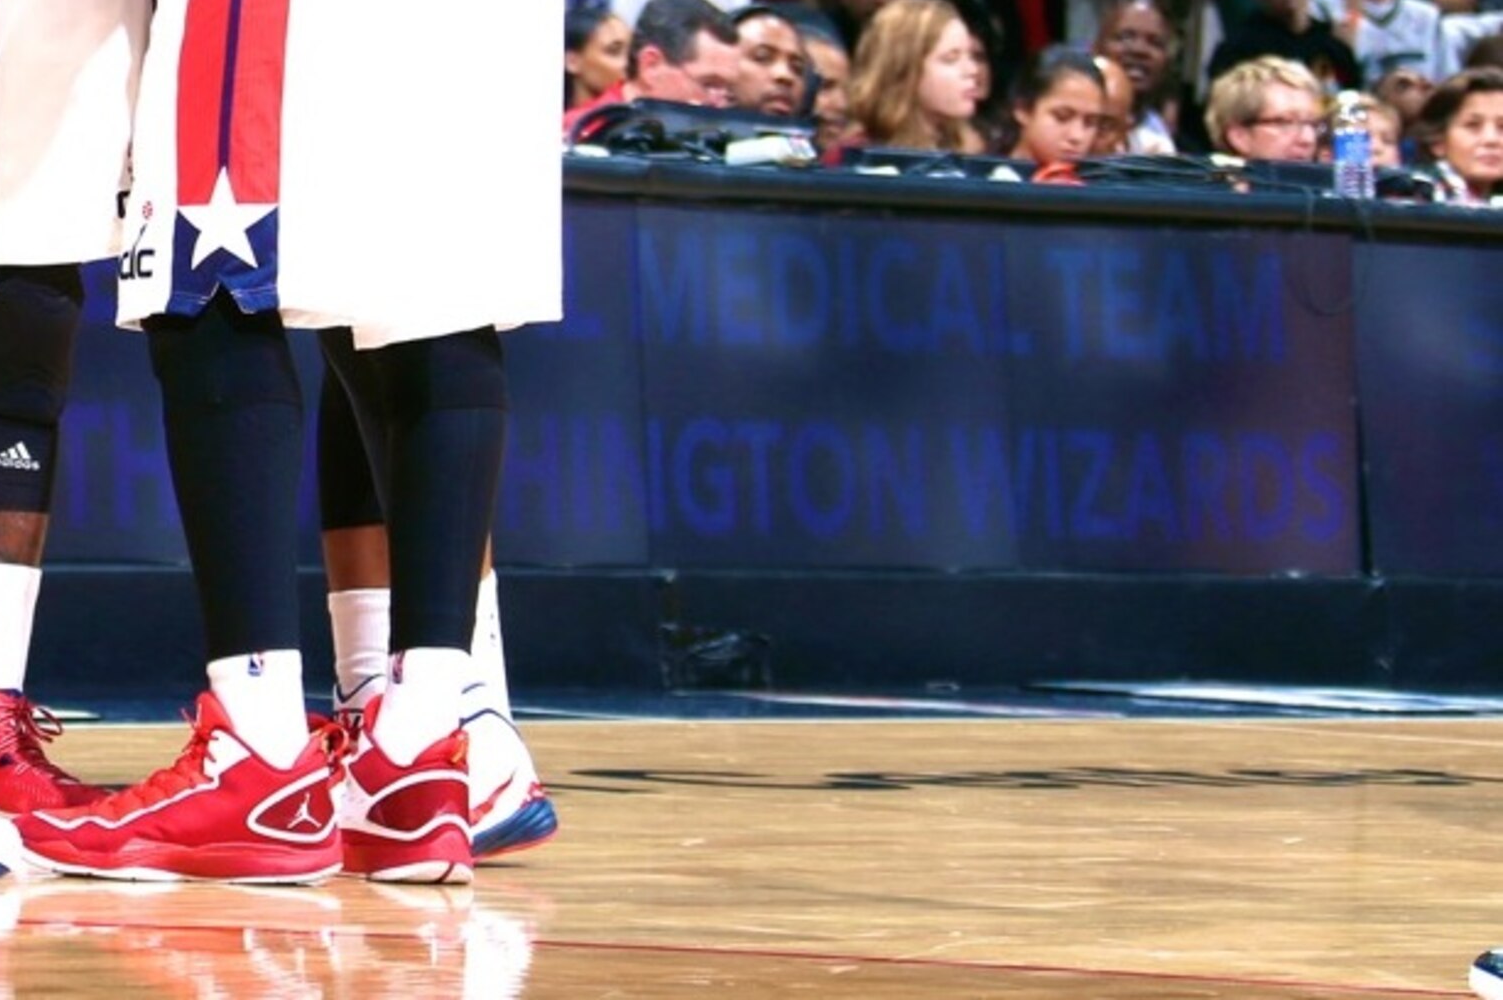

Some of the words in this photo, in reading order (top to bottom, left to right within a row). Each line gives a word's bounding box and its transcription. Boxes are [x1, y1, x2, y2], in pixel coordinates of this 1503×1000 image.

[629, 226, 1035, 355] MEDICAL
[1046, 248, 1289, 364] TEAM
[948, 424, 1345, 543] WIZARDS
